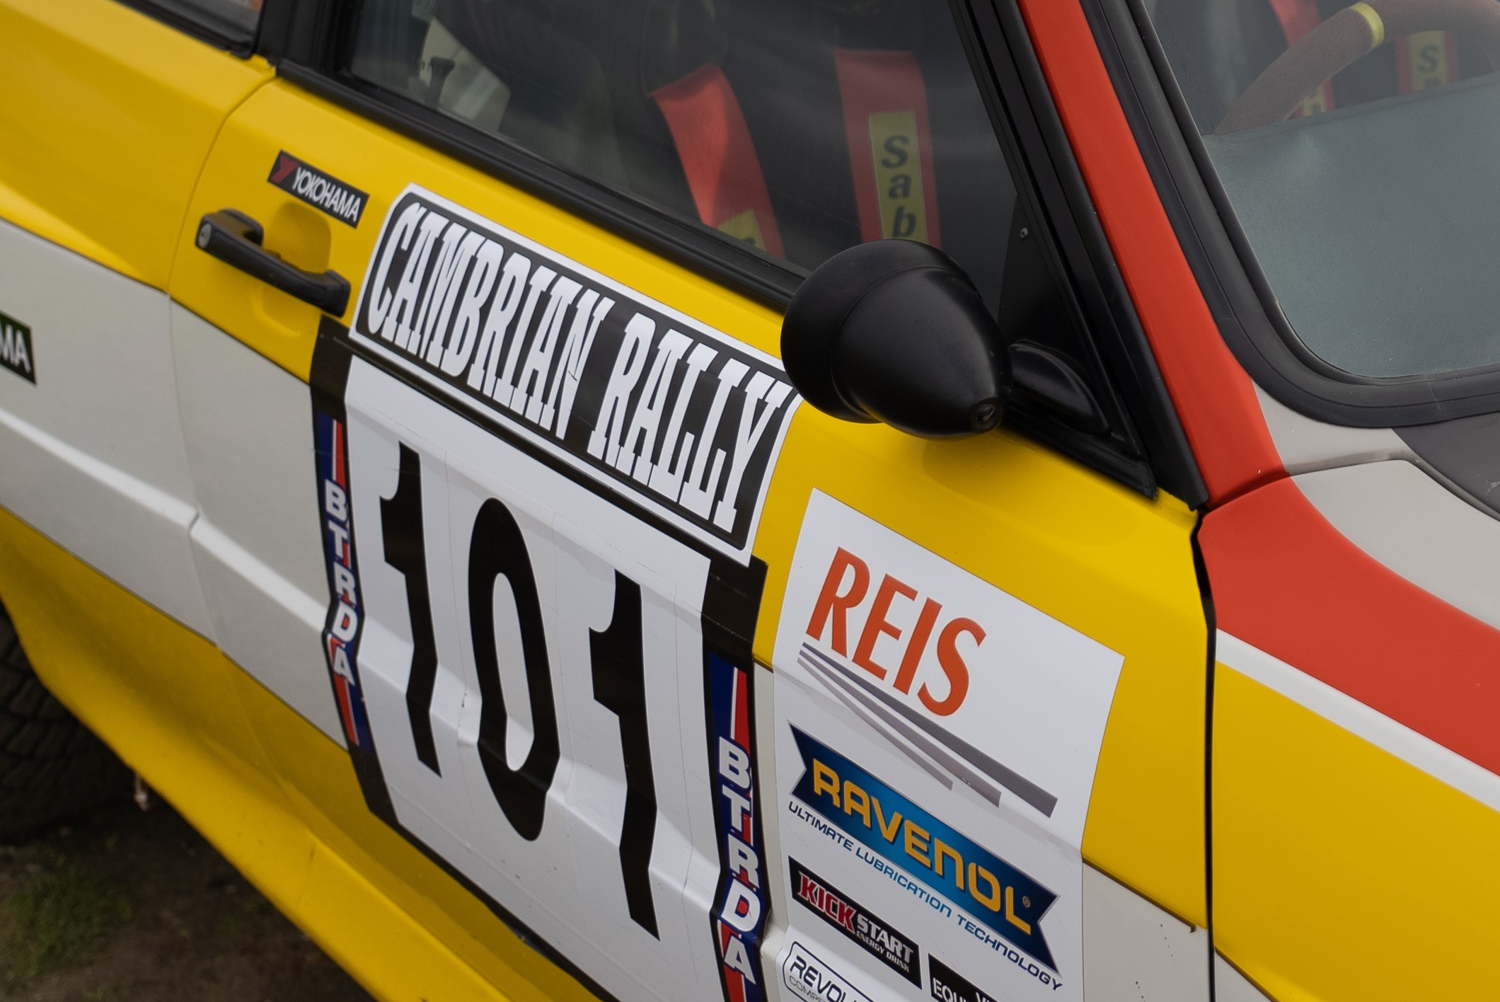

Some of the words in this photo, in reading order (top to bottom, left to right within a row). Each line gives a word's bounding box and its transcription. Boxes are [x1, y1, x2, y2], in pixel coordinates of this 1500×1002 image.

[292, 166, 362, 222] YOKOHAMA
[367, 203, 615, 440] CAMBRIAN
[587, 311, 794, 532] RALLY
[322, 478, 360, 685] BTRDA
[806, 547, 987, 717] REIS
[379, 441, 661, 942] 101
[718, 735, 764, 988] BTRDA
[788, 800, 853, 852] ULTIMATE
[855, 846, 952, 918] LUBRICATION
[956, 913, 1063, 991] TECHNOLOGY
[856, 930, 885, 954] ENERGY
